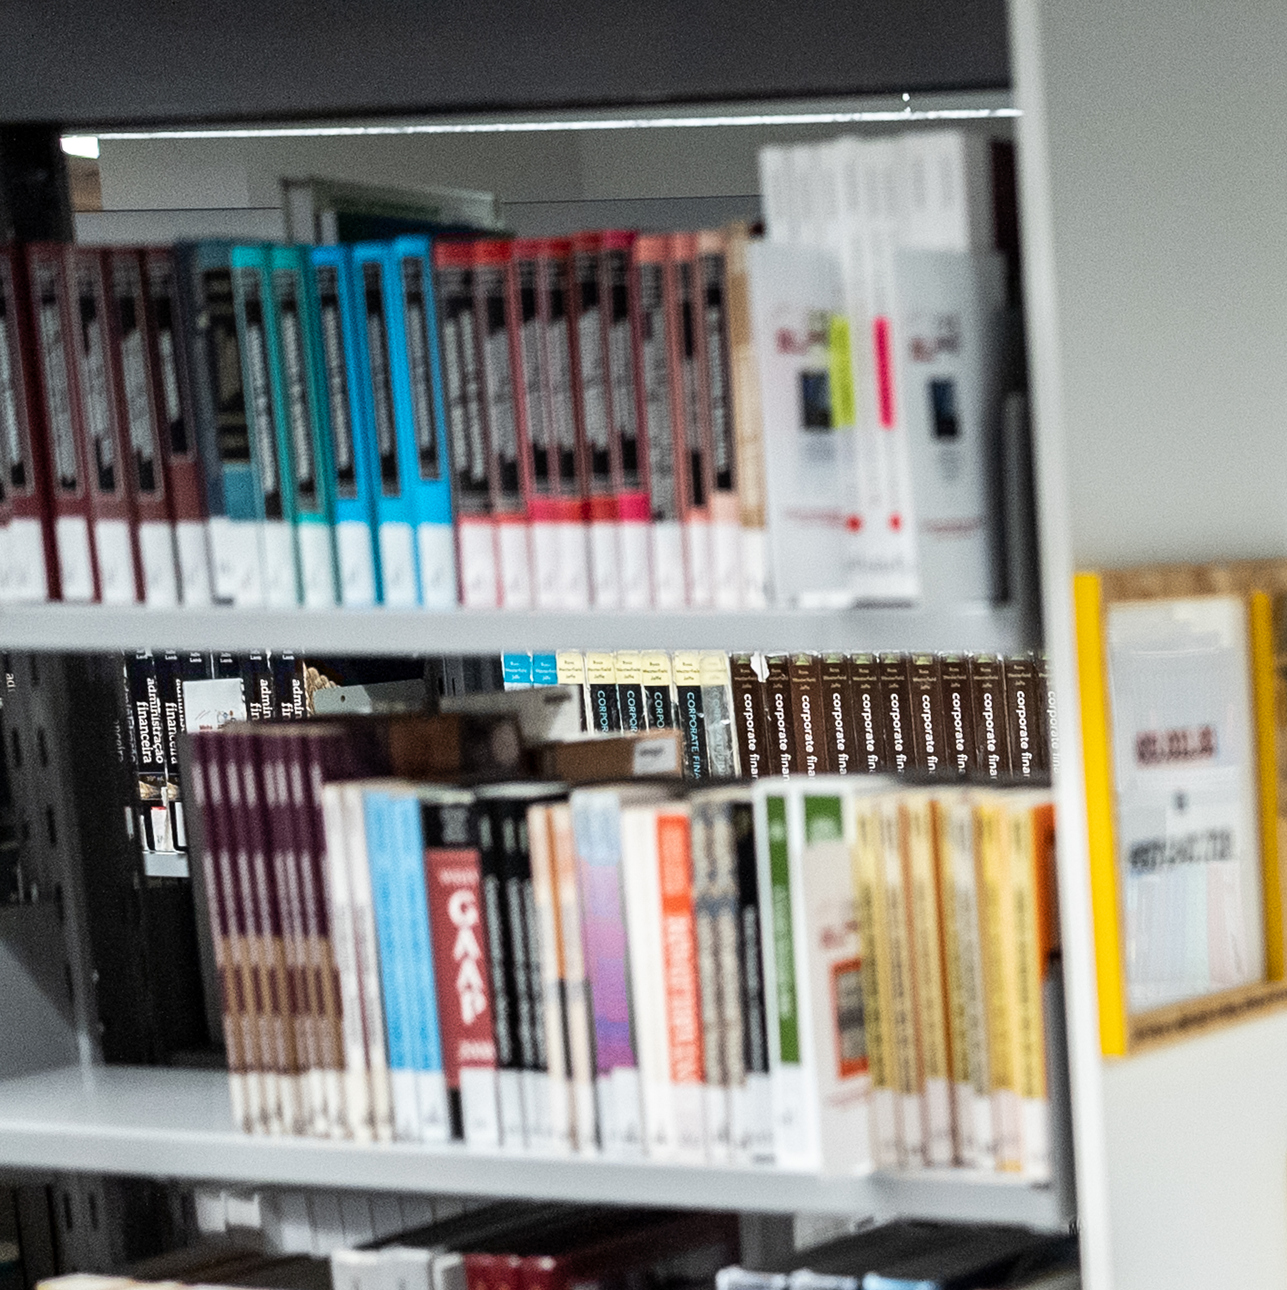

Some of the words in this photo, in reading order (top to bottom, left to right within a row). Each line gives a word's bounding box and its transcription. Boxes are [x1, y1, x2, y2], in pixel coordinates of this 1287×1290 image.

[137, 702, 152, 764] financeira
[146, 678, 164, 764] administração
[686, 691, 701, 753] CORPORATE
[743, 693, 756, 751] corporate
[775, 693, 787, 751] corporate
[862, 693, 875, 751] corporate
[922, 694, 934, 753] corporate
[1016, 690, 1029, 749] corporate
